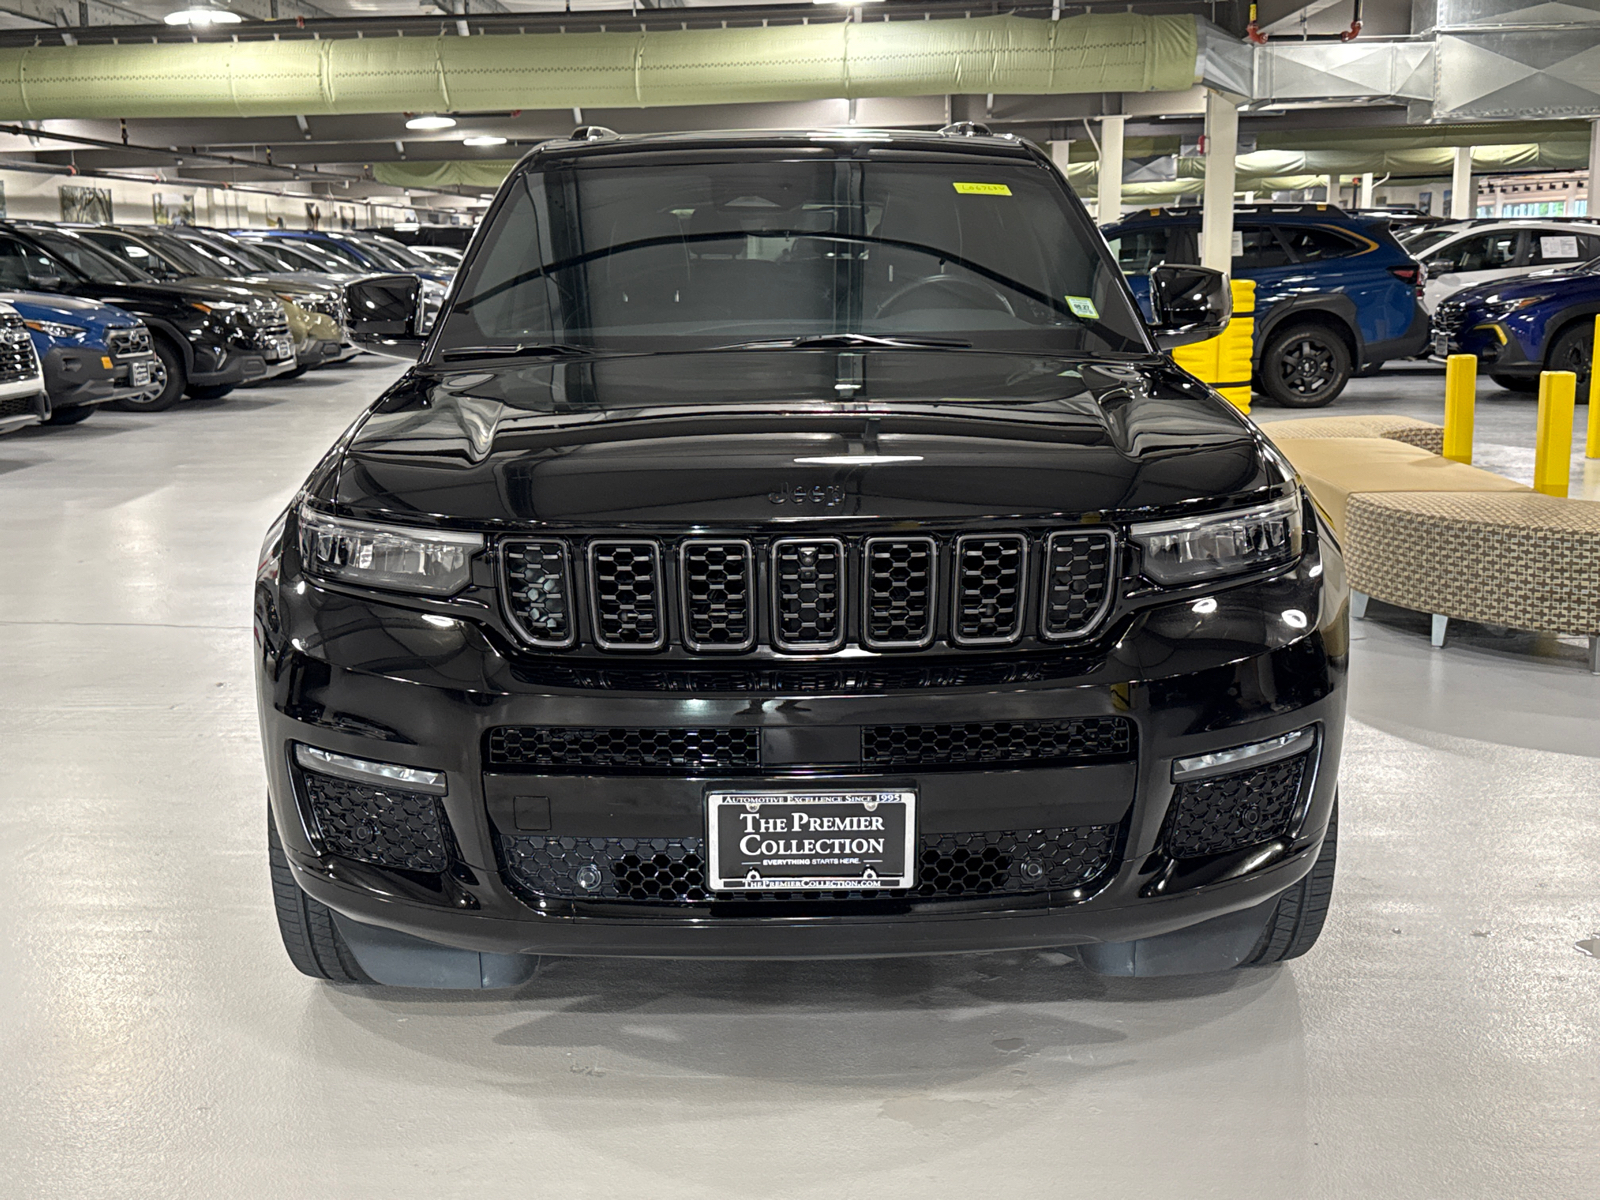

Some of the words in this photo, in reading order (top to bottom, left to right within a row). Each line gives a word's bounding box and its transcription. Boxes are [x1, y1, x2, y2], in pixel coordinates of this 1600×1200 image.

[876, 794, 900, 802] 1995
[739, 813, 788, 833] THE
[790, 812, 885, 832] PREMIER
[739, 834, 885, 856] COLLECTION
[762, 858, 811, 866] EVERYTHING
[839, 857, 861, 865] HERE.
